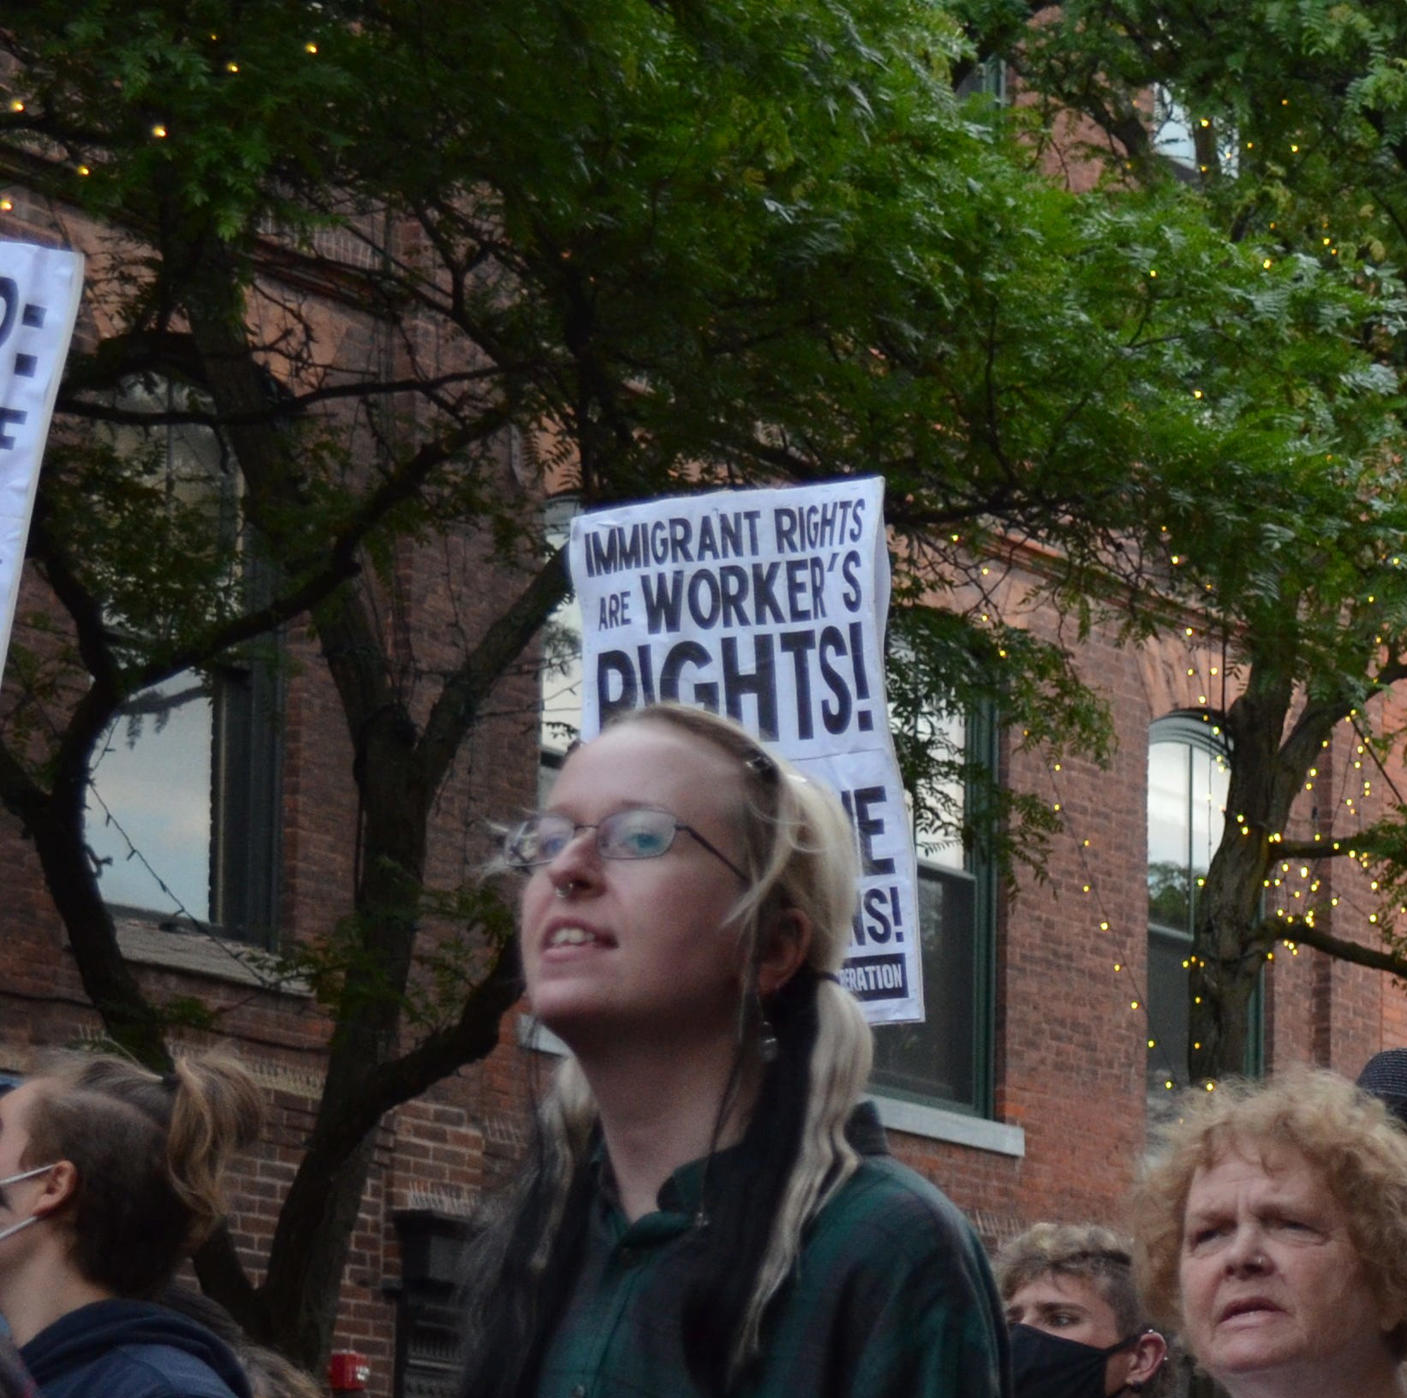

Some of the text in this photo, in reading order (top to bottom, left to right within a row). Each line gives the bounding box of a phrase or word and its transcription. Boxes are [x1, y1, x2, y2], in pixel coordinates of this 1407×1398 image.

[584, 498, 866, 577] IMMIGRANT RIGHTS
[599, 549, 863, 634] ARE WORKER'S
[596, 622, 874, 742] RIGHTS!
